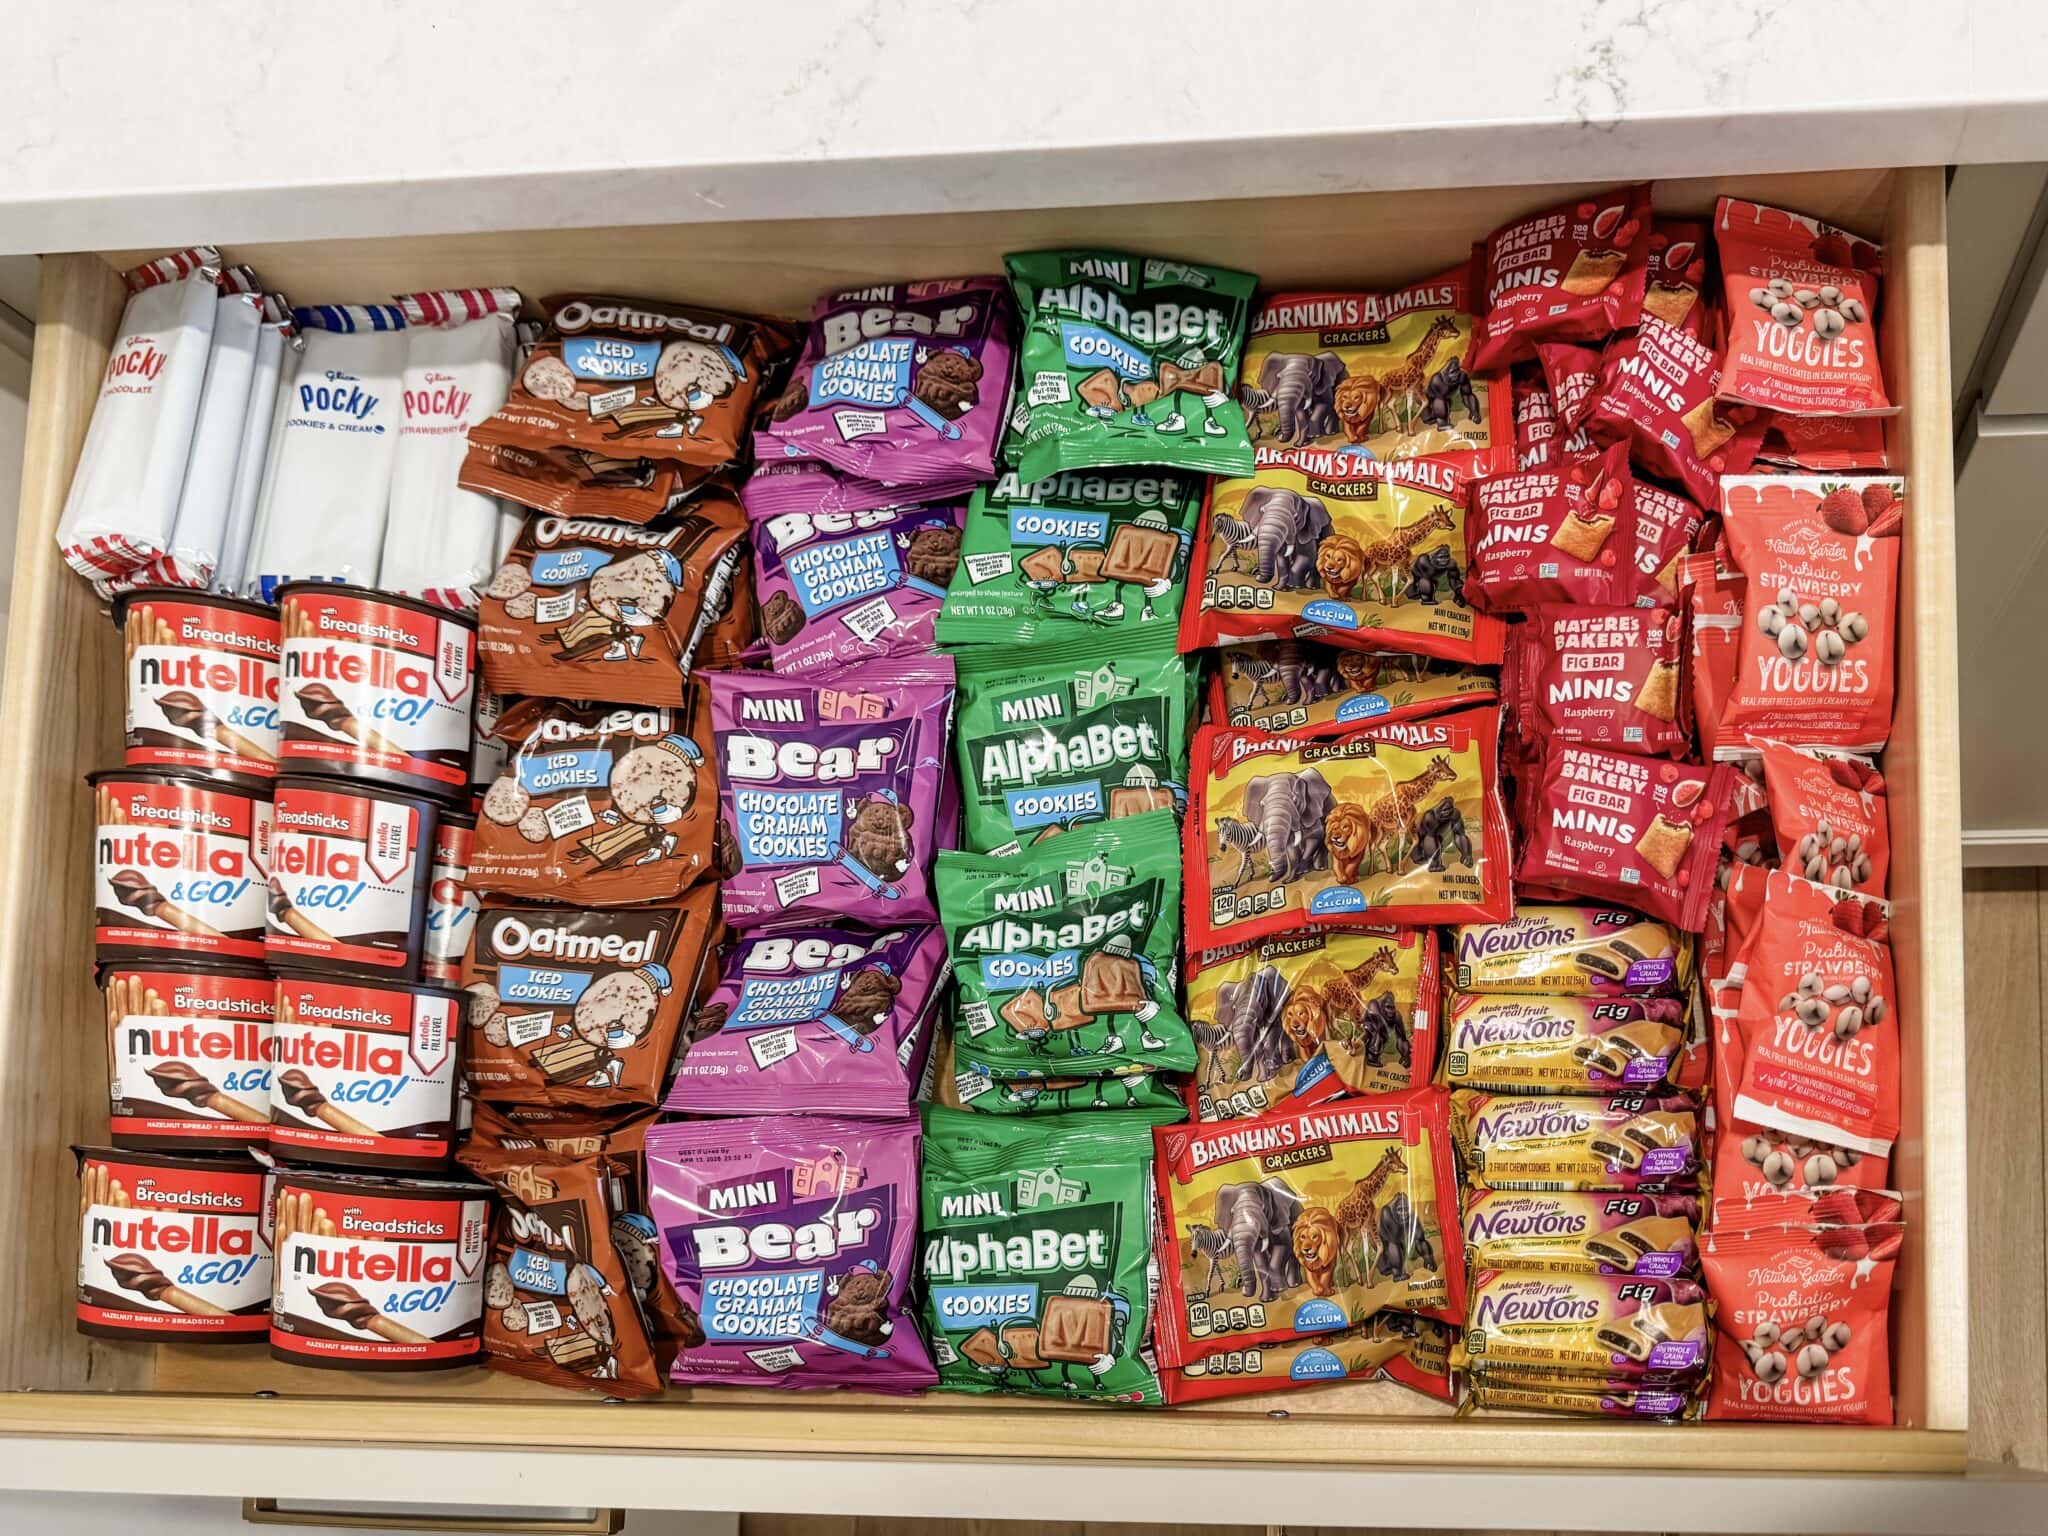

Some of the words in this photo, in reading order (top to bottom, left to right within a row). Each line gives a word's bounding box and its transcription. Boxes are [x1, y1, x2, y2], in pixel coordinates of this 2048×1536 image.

[1573, 224, 1588, 233] 100
[1070, 259, 1129, 286] MINI
[1496, 292, 1542, 310] Raspberry
[555, 302, 732, 342] Oatmeal
[1038, 284, 1225, 345] AlphaBet
[823, 305, 973, 356] Bear
[1323, 327, 1386, 344] CRACKERS
[1753, 319, 1864, 369] YOGGIES
[1069, 336, 1152, 377] COOKIES
[823, 361, 897, 382] GRAHAM
[819, 379, 894, 403] COOKIES
[1618, 356, 1686, 413] MINIS
[1621, 380, 1665, 416] Raspberry
[339, 423, 373, 433] CREAM
[1311, 480, 1373, 496] CRACKERS
[1489, 508, 1511, 520] FIG
[1512, 504, 1539, 517] BAR
[1016, 514, 1100, 539] COOKIES
[1476, 524, 1550, 554] MINIS
[560, 552, 582, 564] ICED
[790, 535, 889, 574] CHOCOLATE
[1485, 548, 1532, 562] Raspberry
[541, 564, 589, 580] COOKIES
[804, 558, 884, 588] GRAHAM
[810, 570, 888, 605] COOKIES
[1760, 572, 1863, 597] STRAWBERRY
[951, 606, 965, 615] NET
[967, 606, 978, 615] WT
[986, 606, 995, 615] OZ
[996, 606, 1015, 617] (28g)
[1307, 607, 1353, 622] CALCIUM
[320, 616, 418, 646] Breadsticks
[285, 648, 428, 697] nutella
[1566, 656, 1589, 669] FIG
[1592, 655, 1620, 668] BAR
[1758, 656, 1870, 693] YOGGIES
[1549, 677, 1634, 705] MINIS
[742, 698, 804, 722] MINI
[1001, 693, 1062, 722] MINI
[1340, 700, 1385, 716] CALCIUM
[1563, 706, 1616, 720] Raspberry
[547, 754, 578, 770] ICED
[727, 735, 895, 781] Bear
[983, 722, 1159, 784] AlphaBet
[1304, 743, 1371, 759] CRACKERS
[534, 769, 598, 787] COOKIES
[1560, 764, 1647, 795] BAKERY
[1573, 789, 1595, 804] FIG
[1598, 793, 1626, 810] BAR
[1654, 784, 1668, 795] 100
[739, 792, 838, 816] CHOCOLATE
[1014, 791, 1098, 816] COOKIES
[131, 803, 231, 828] Breadsticks
[750, 815, 828, 836] GRAHAM
[1552, 807, 1637, 844] MINIS
[378, 822, 389, 858] nutella
[750, 837, 828, 857] COOKIES
[1564, 834, 1616, 857] Raspberry
[99, 832, 244, 878] nutella
[171, 878, 250, 907] &GO!
[995, 885, 1054, 912] MINI
[1216, 896, 1234, 908] 120
[1316, 896, 1361, 908] CALCIUM
[961, 900, 1147, 952] AlphaBet
[1524, 916, 1549, 928] fruit
[1593, 913, 1629, 925] Fig
[492, 916, 657, 963] Oatmeal
[1261, 937, 1322, 956] CRACKERS
[1460, 925, 1575, 962] Newtons
[528, 970, 563, 985] ICED
[989, 956, 1074, 978] COOKIES
[508, 984, 573, 1001] COOKIES
[747, 972, 835, 998] CHOCOLATE
[749, 992, 822, 1010] GRAHAM
[1479, 1004, 1500, 1015] Made
[1500, 1007, 1523, 1018] real
[1524, 1005, 1550, 1018] fruit
[1593, 1004, 1630, 1020] Fig
[299, 1002, 392, 1026] Breadsticks
[738, 1006, 814, 1023] COOKIES
[420, 1015, 429, 1050] nutella
[1459, 1015, 1575, 1049] Newtons
[1773, 1015, 1875, 1077] YOGGIES
[1451, 1056, 1466, 1065] 200
[331, 1076, 409, 1106] &GO!
[1609, 1098, 1644, 1113] Fig
[1301, 1111, 1399, 1140] ANIMALS
[1476, 1110, 1591, 1145] Newtons
[136, 1187, 242, 1207] Breadsticks
[709, 1181, 777, 1210] MINI
[941, 1192, 1001, 1218] MINI
[1489, 1200, 1512, 1210] Made
[1511, 1202, 1533, 1212] real
[1534, 1200, 1561, 1212] fruit
[344, 1207, 361, 1215] with
[1606, 1199, 1640, 1216] Fig
[93, 1216, 251, 1255] nutella
[343, 1216, 443, 1235] Breadsticks
[1468, 1210, 1586, 1242] Newtons
[692, 1208, 875, 1268] Bear
[294, 1245, 452, 1282] nutella
[923, 1228, 1107, 1281] AlphaBet
[1653, 1256, 1674, 1264] WHOLE
[179, 1254, 259, 1286] &GO!
[1747, 1268, 1798, 1287] Nature's
[384, 1280, 456, 1313] &GO!
[708, 1274, 819, 1297] CHOCOLATE
[1499, 1281, 1521, 1291] Made
[1520, 1285, 1542, 1296] real
[1542, 1283, 1572, 1296] fruit
[1619, 1284, 1656, 1301] Fig
[715, 1296, 803, 1317] GRAHAM
[942, 1294, 1031, 1316] COOKIES
[1192, 1306, 1209, 1320] 120
[1477, 1292, 1600, 1326] Newtons
[1733, 1297, 1852, 1324] STRAWBERRY
[102, 1312, 133, 1322] HAZELNUT
[135, 1315, 163, 1323] SPREAD
[172, 1316, 224, 1326] BREADSTICKS
[711, 1314, 802, 1336] COOKIES
[1298, 1314, 1343, 1325] CALCIUM
[306, 1340, 338, 1350] HAZELNUT
[341, 1344, 369, 1352] SPREAD
[378, 1345, 427, 1353] BREADSTICKS
[1494, 1345, 1511, 1356] FRUIT
[1513, 1345, 1529, 1357] CHEWY
[1530, 1346, 1554, 1359] COOKIES
[1559, 1351, 1570, 1360] NET
[1571, 1351, 1579, 1361] WT
[1585, 1352, 1593, 1362] OZ
[1666, 1346, 1689, 1354] WHOLE
[1295, 1363, 1340, 1374] CALCIUM
[1738, 1366, 1856, 1406] YOGGIES
